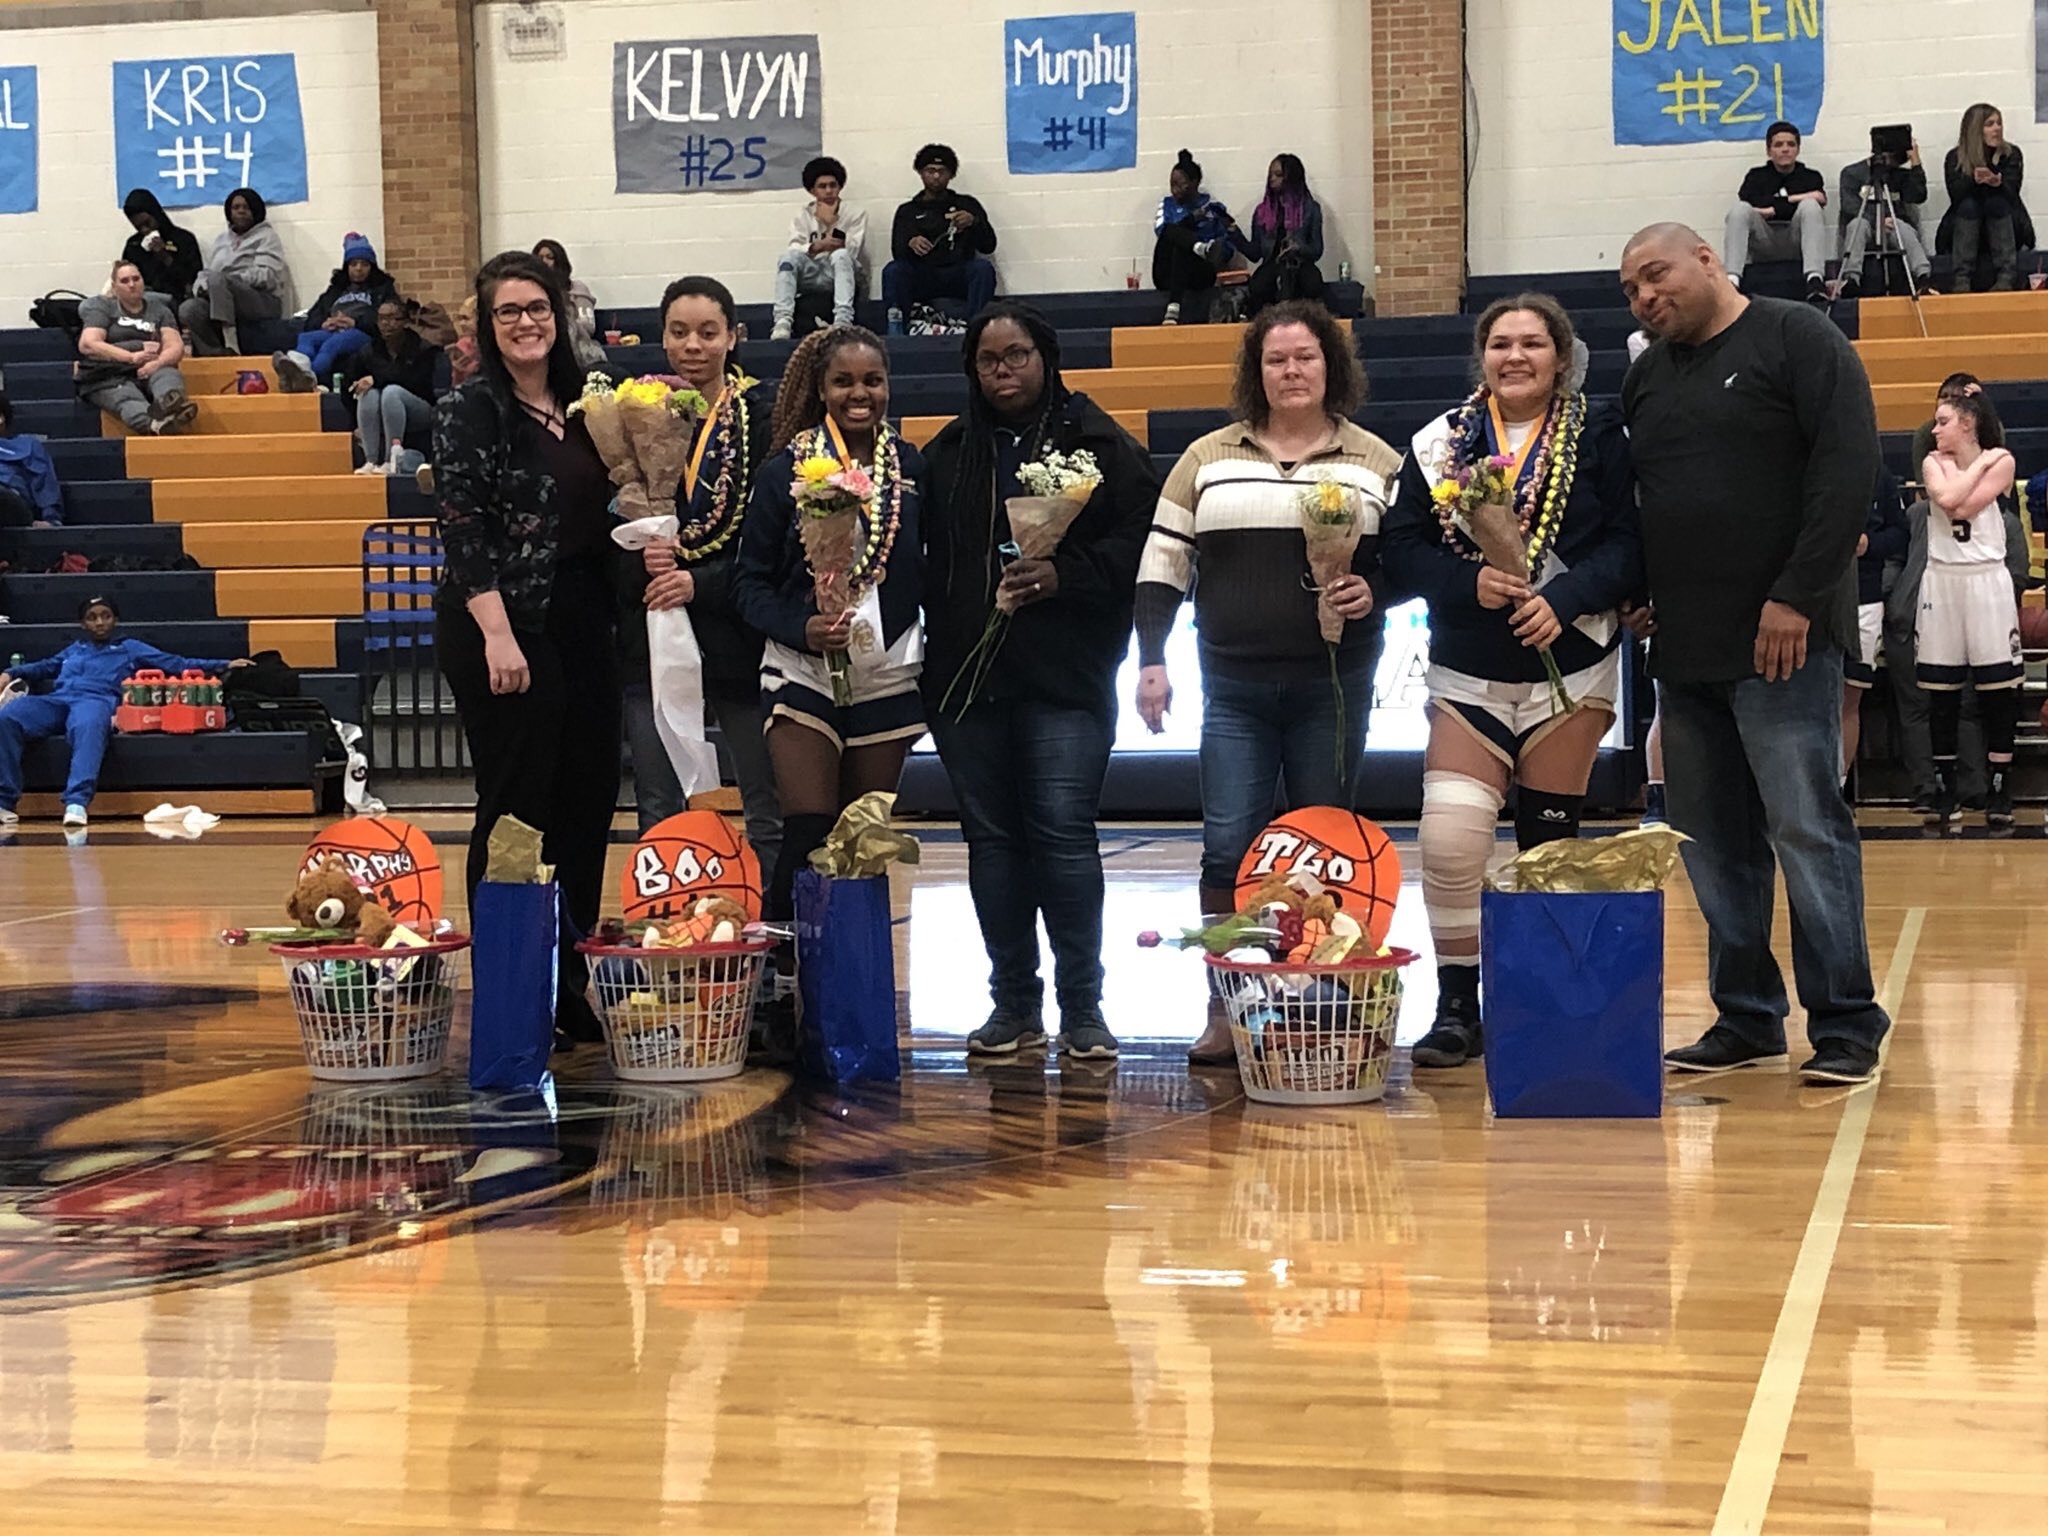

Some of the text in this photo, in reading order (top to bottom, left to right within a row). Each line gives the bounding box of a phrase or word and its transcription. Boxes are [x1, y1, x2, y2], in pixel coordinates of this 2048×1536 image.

[1616, 0, 1819, 55] JALEN
[143, 60, 267, 131] KRIS
[626, 46, 809, 122] KELVYN
[1013, 32, 1131, 115] Murphy
[1656, 62, 1784, 126] #21
[156, 130, 254, 190] #4
[678, 134, 767, 187] #25
[1043, 116, 1107, 152] #41
[1245, 830, 1356, 884] TLO
